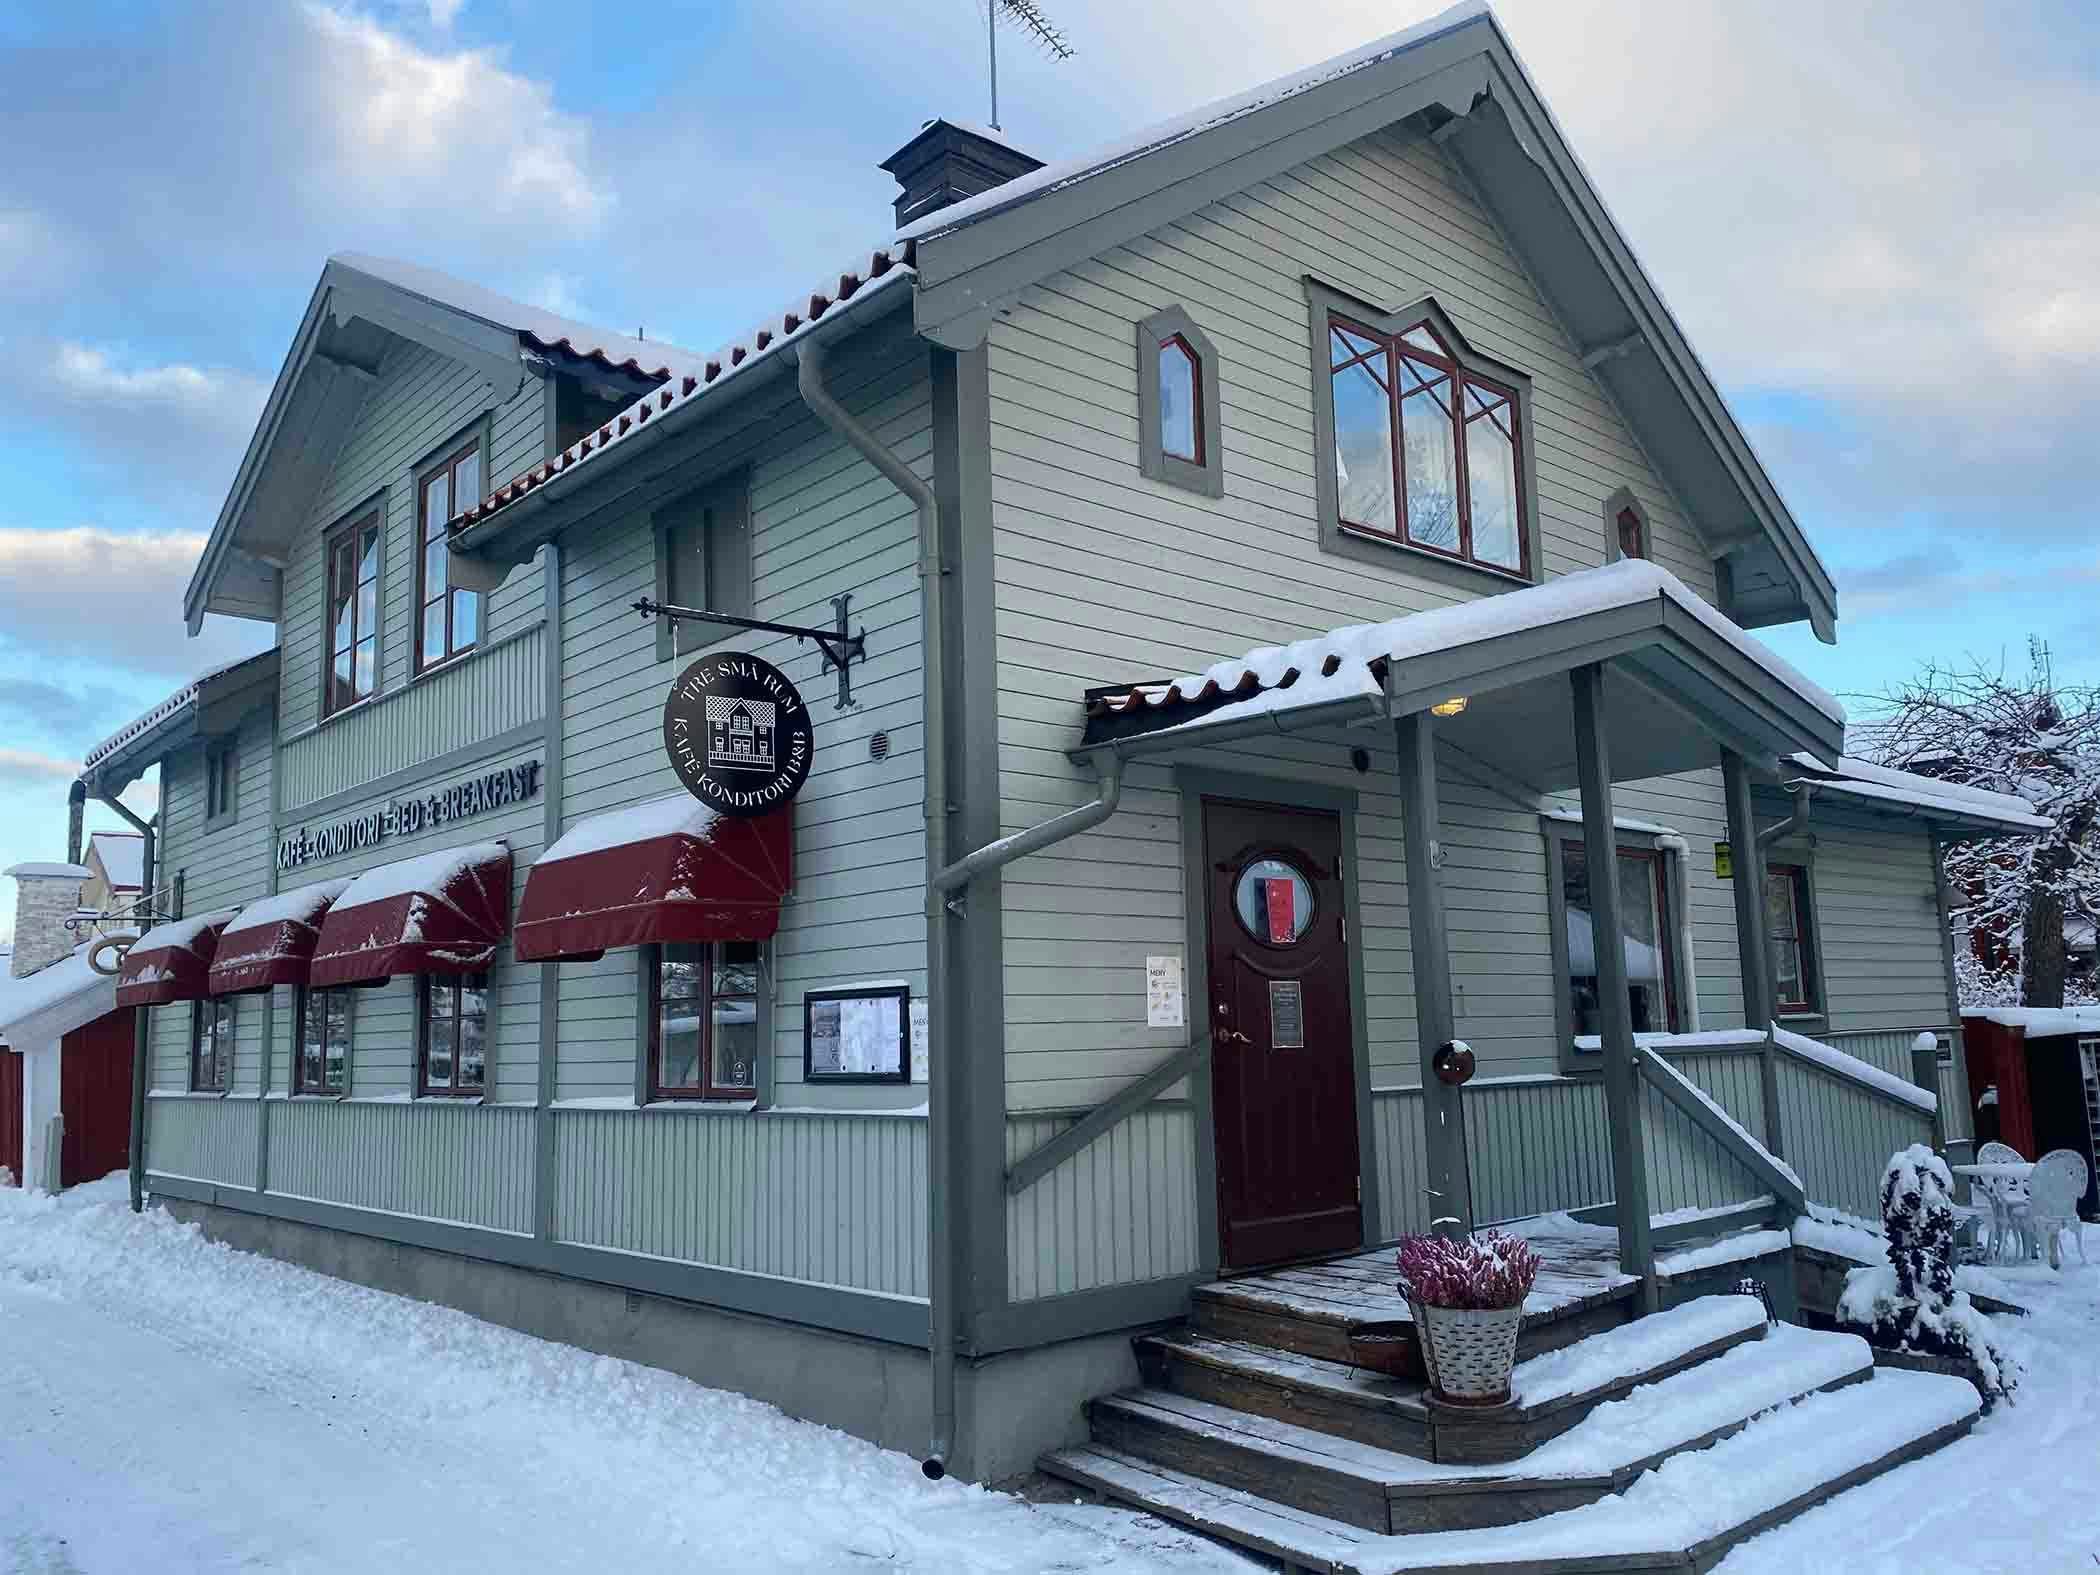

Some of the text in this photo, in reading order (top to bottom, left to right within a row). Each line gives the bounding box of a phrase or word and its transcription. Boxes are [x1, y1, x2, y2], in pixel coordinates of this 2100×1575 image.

[681, 667, 715, 702] TRE
[763, 674, 798, 714] RUM
[697, 772, 793, 806] KONDITORI
[786, 731, 806, 774] B&B
[276, 827, 304, 870] KAFÉ
[313, 812, 382, 860] KONDITORI
[392, 800, 420, 836] BED
[424, 795, 436, 826] &
[440, 760, 538, 824] BREAKFAST
